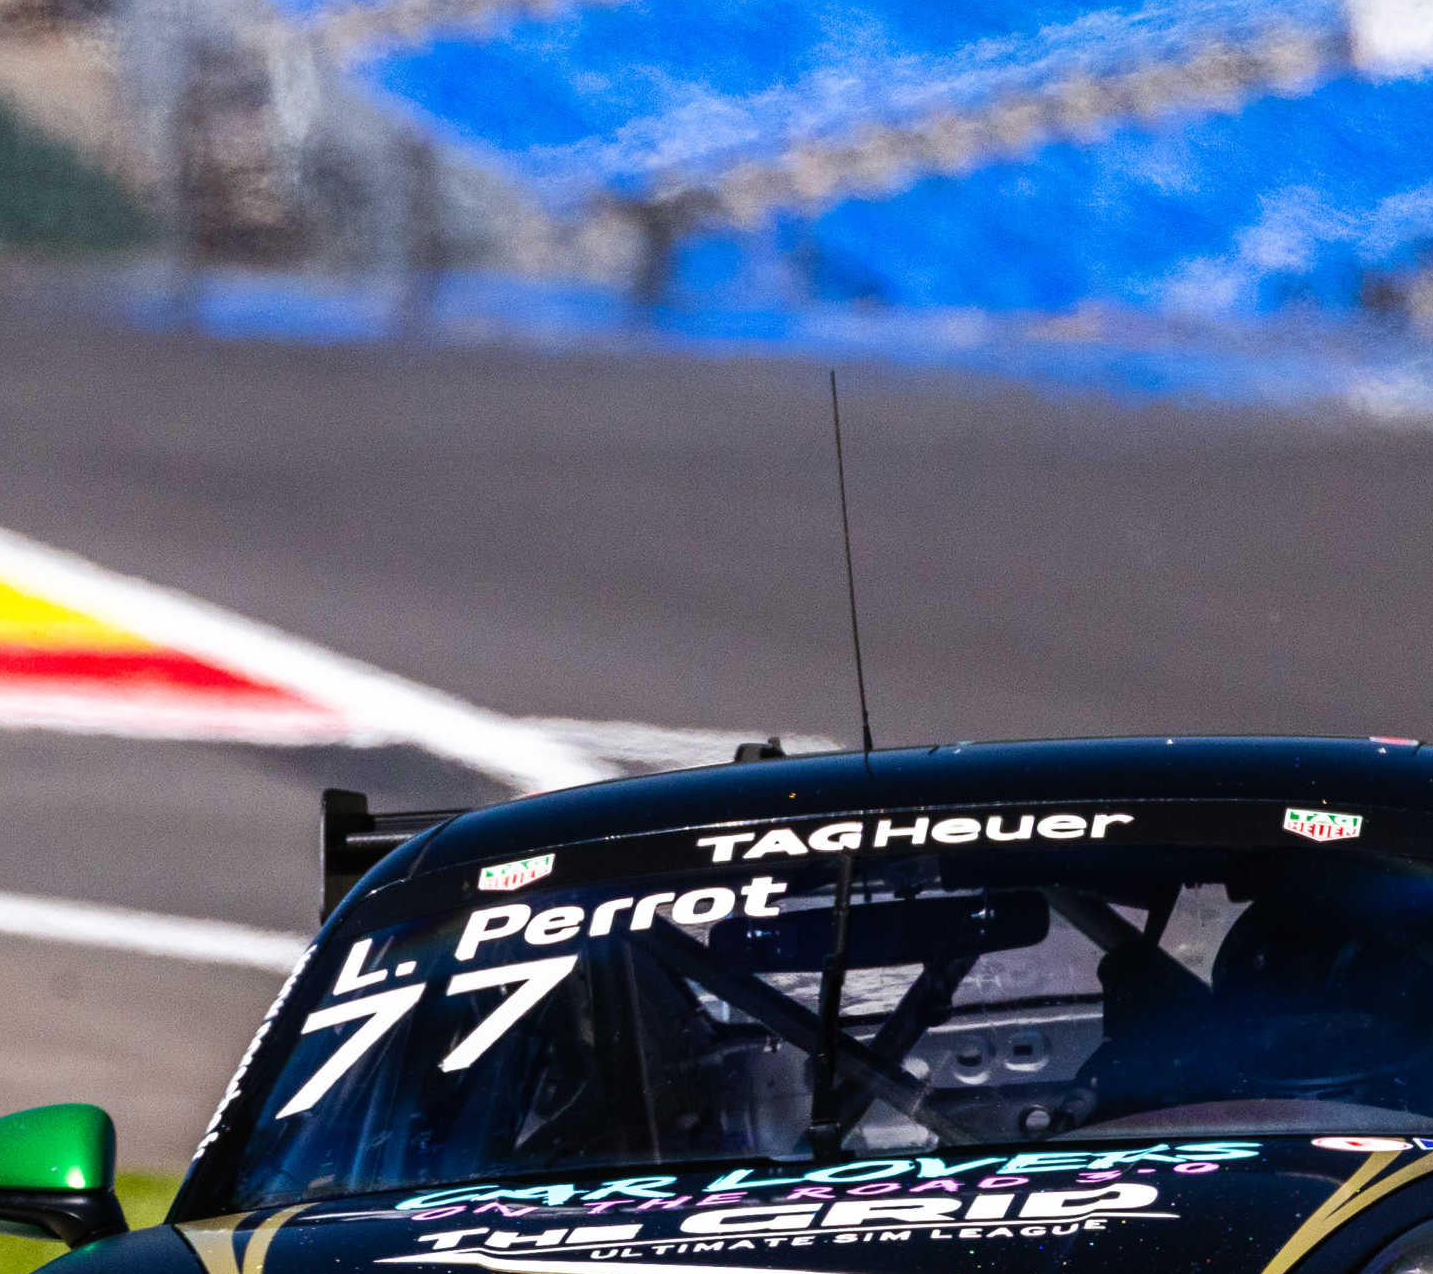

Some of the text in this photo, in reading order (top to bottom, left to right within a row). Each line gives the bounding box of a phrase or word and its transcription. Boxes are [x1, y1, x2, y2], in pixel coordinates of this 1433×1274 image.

[333, 876, 788, 996] L. Perrot
[275, 954, 579, 1120] 77
[394, 1142, 1263, 1211] CAR LOVERS
[411, 1201, 538, 1221] ON
[583, 1191, 748, 1215] THE
[786, 1175, 1031, 1201] ROAD
[418, 1182, 1159, 1251] THE GRID
[590, 1219, 1109, 1260] ULTIMATE SIM LEAGUE
